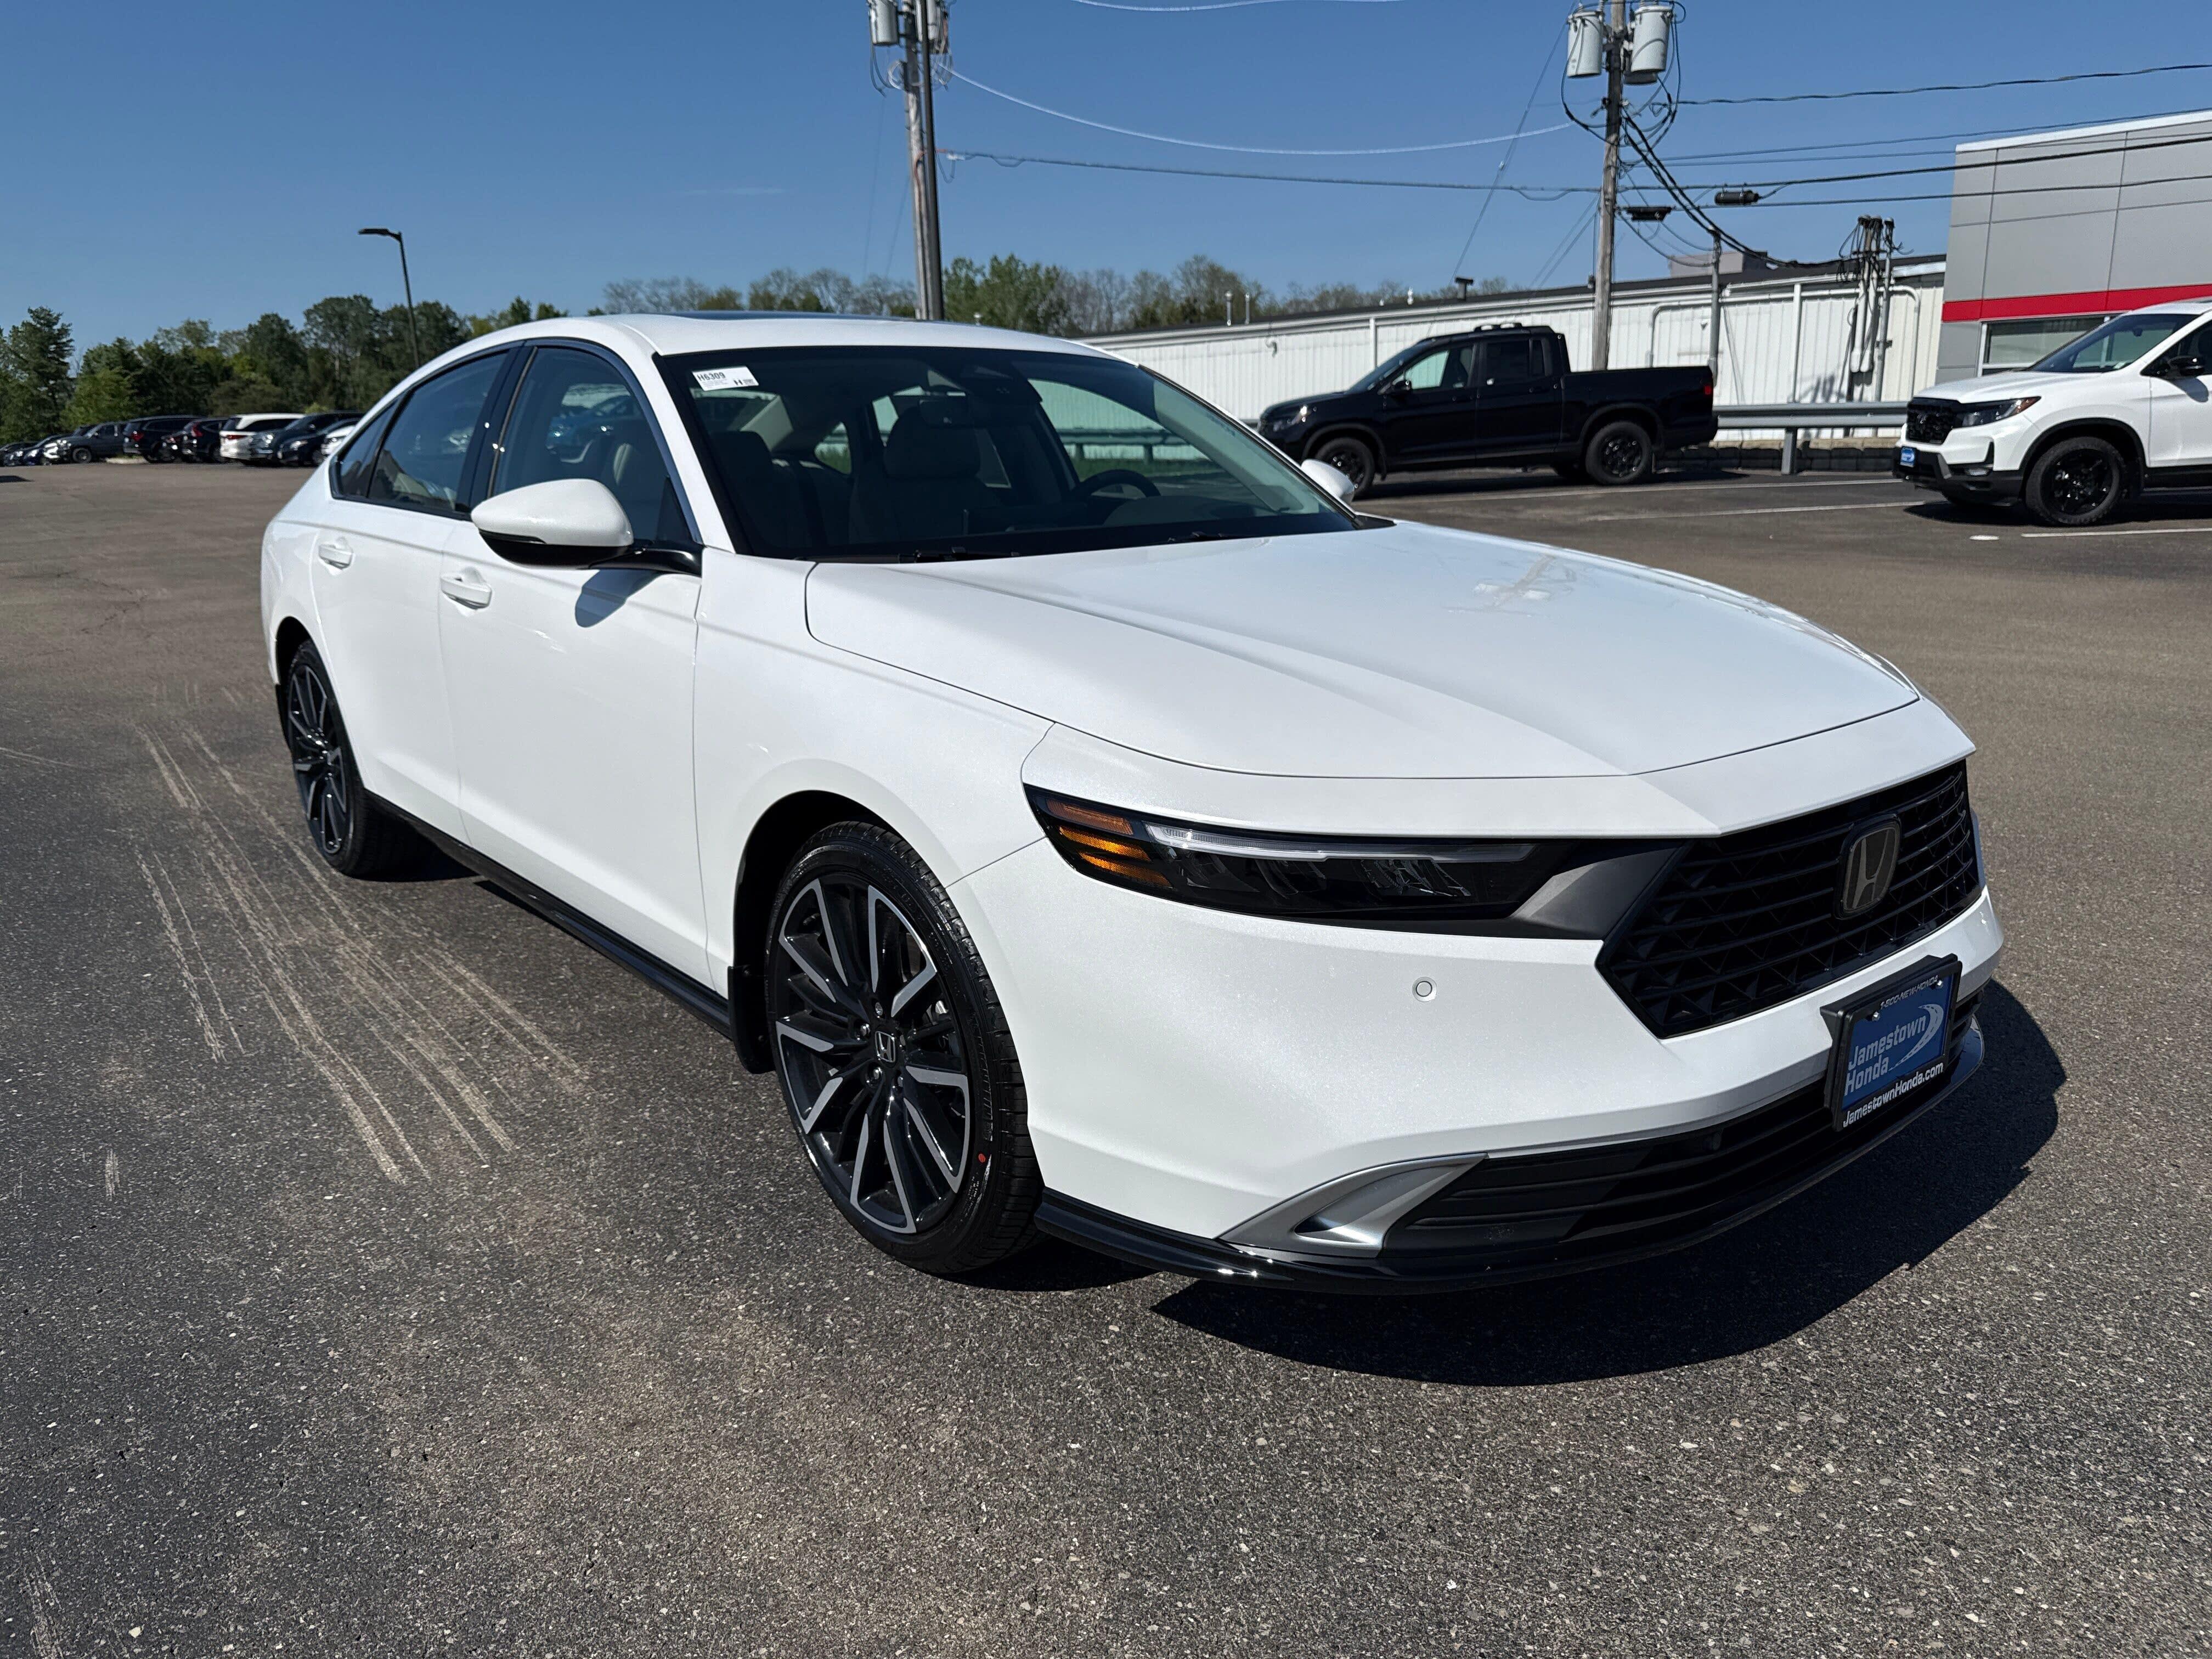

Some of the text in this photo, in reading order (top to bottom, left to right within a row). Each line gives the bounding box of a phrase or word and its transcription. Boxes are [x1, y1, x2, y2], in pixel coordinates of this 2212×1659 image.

[697, 372, 726, 381] H6309
[1848, 1015, 1926, 1069] Jamestown
[1843, 1062, 1943, 1128] JamestownHonda.com
[1844, 1056, 1889, 1096] Honda
